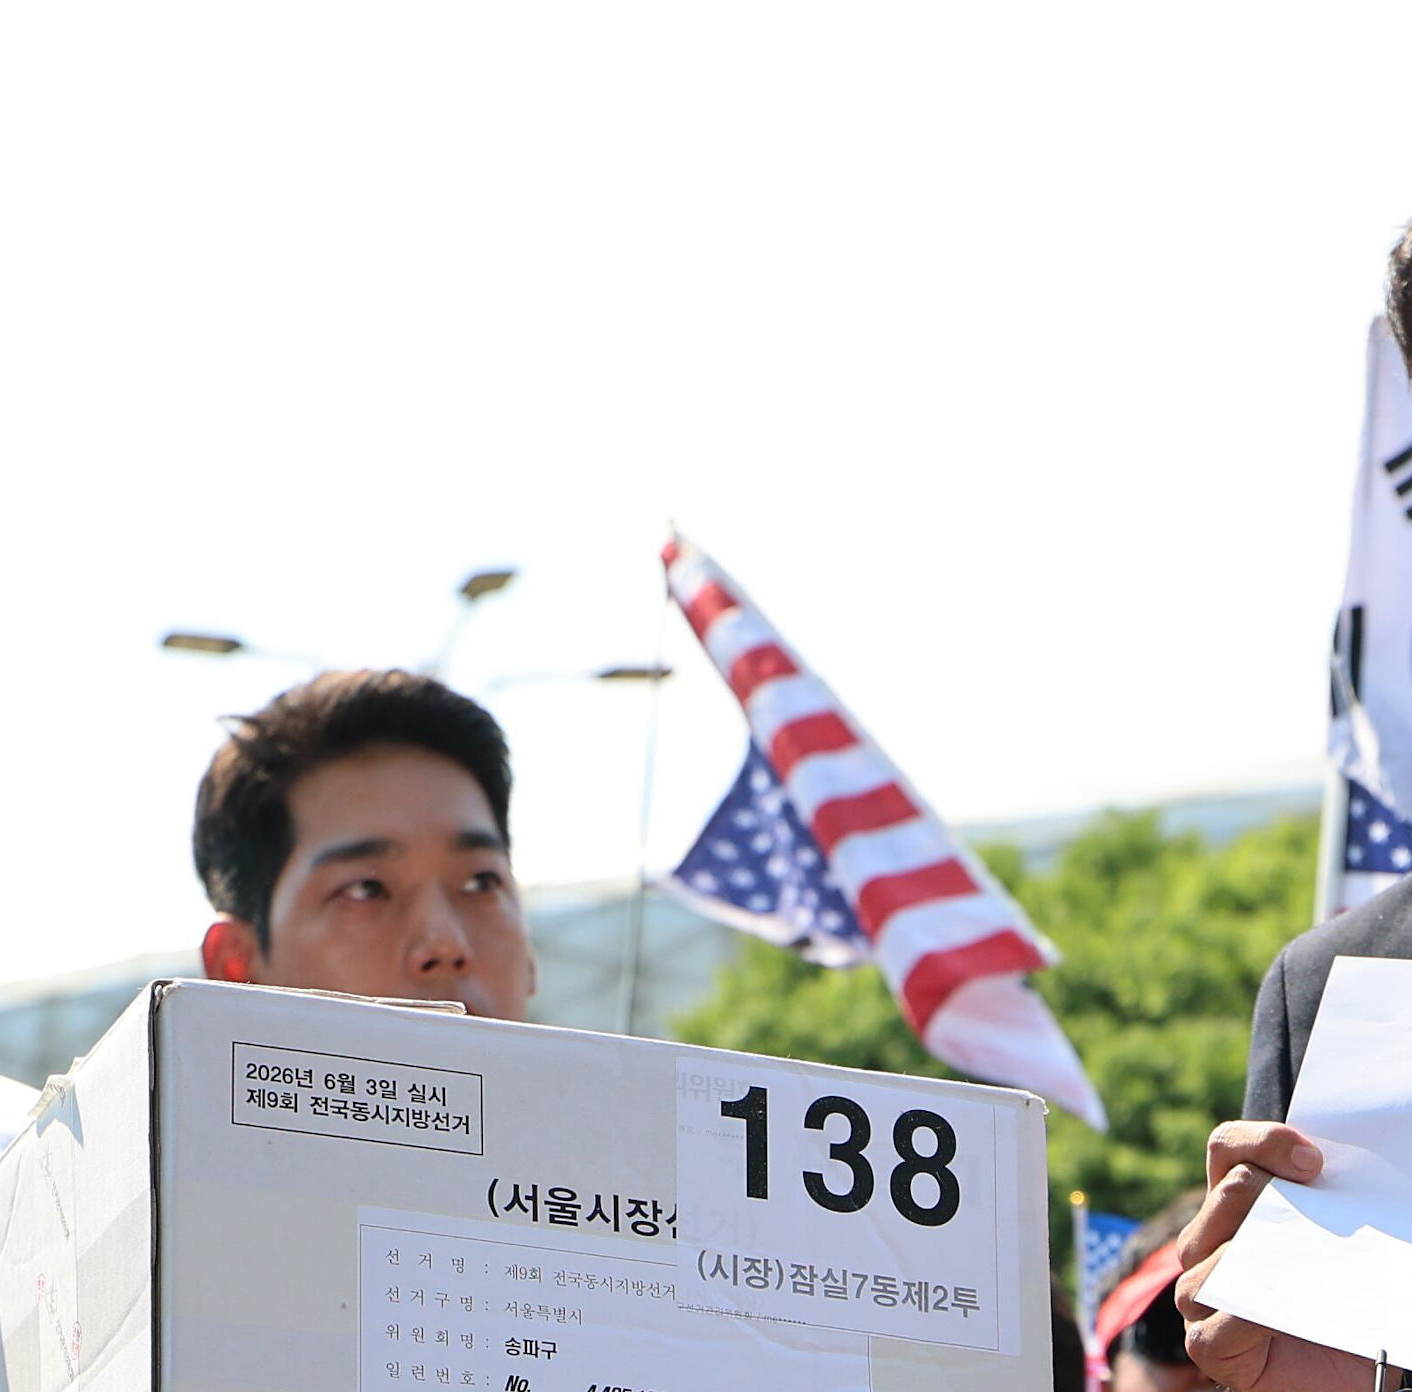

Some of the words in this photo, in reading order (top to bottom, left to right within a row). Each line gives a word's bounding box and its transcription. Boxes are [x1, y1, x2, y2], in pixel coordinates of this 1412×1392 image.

[245, 1062, 314, 1089] 2026년
[324, 1072, 356, 1095] 6월
[366, 1078, 398, 1100] 3일
[407, 1083, 447, 1107] 실시
[245, 1087, 299, 1112] 제9회
[309, 1094, 471, 1134] 전국동시지방선거
[720, 1085, 960, 1227] 138
[504, 1264, 543, 1283] 제9회
[553, 1270, 676, 1301] 전국동시지방선거
[697, 1250, 981, 1319] (시장)잠실7동제2투
[504, 1302, 584, 1327] 서울특별시
[504, 1337, 558, 1360] 송파구
